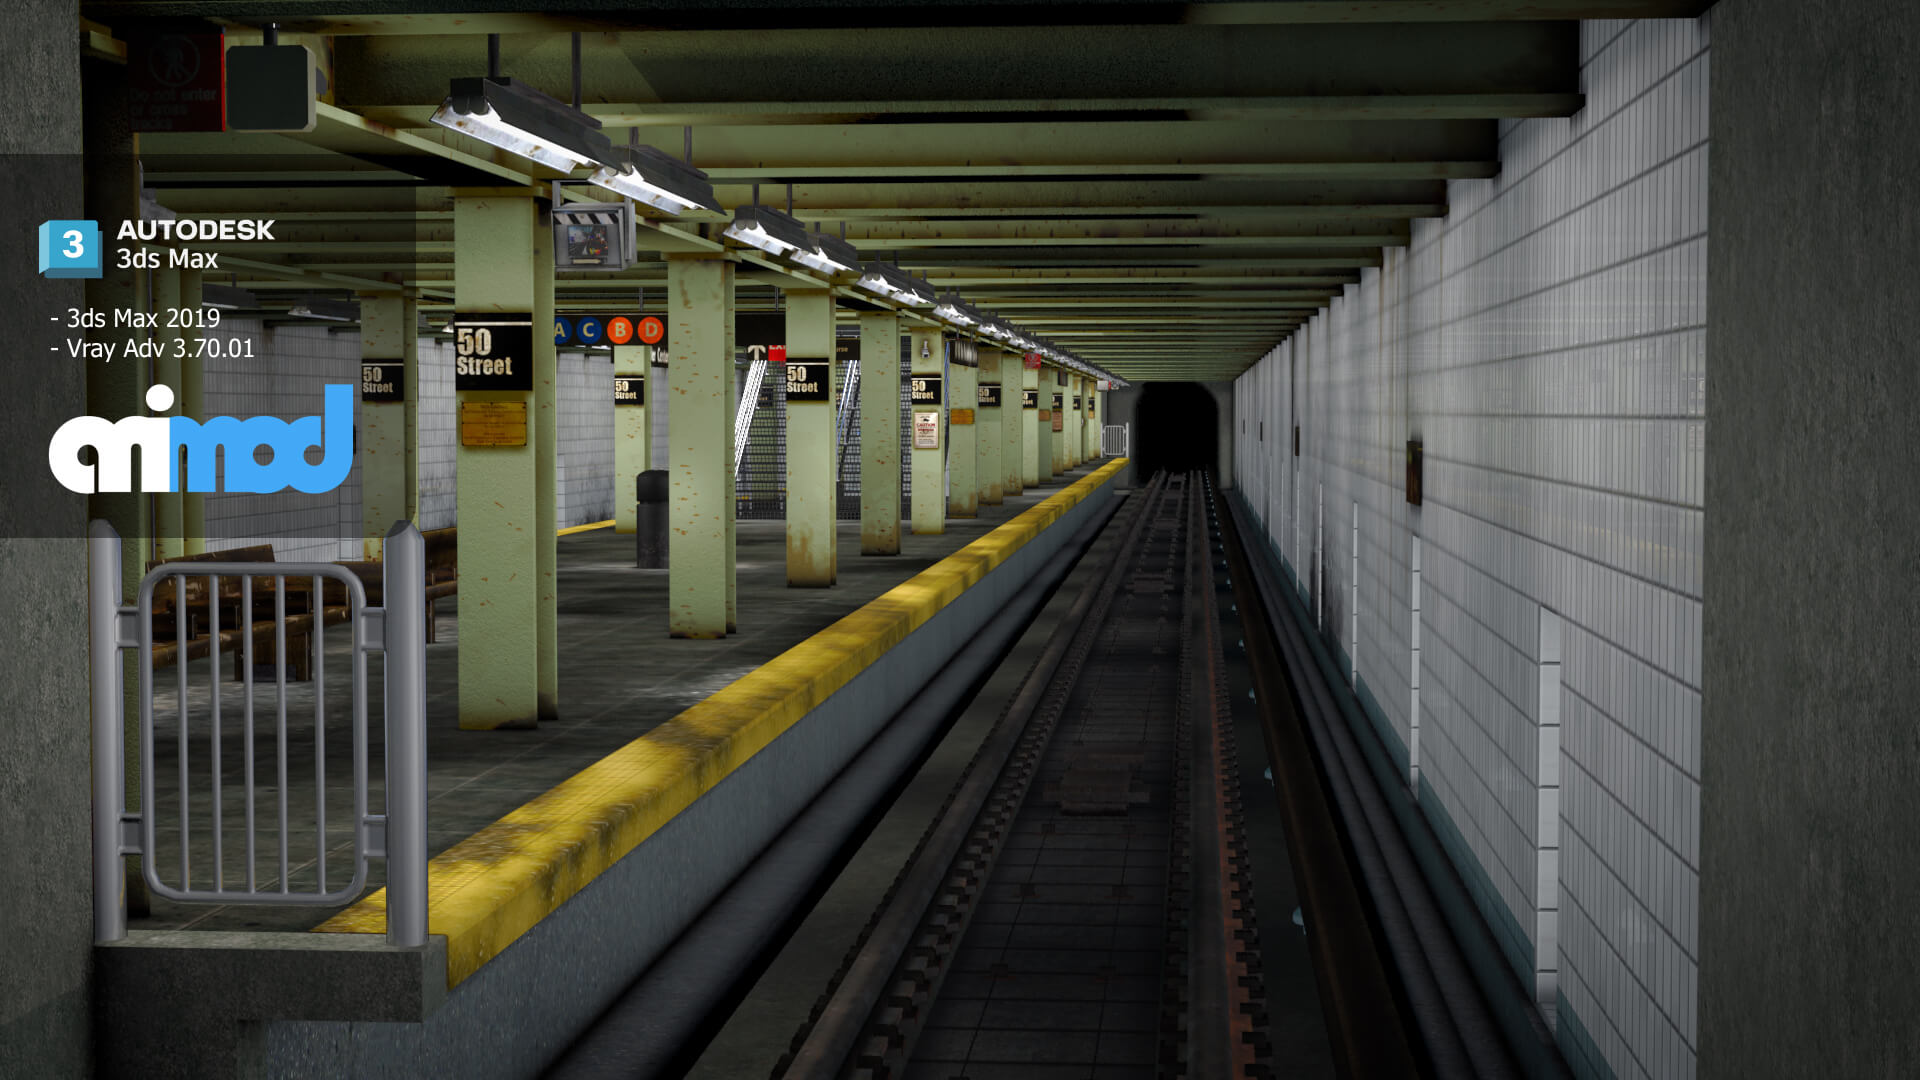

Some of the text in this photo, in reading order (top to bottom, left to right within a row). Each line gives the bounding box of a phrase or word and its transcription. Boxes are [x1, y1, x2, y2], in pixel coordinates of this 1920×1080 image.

[583, 322, 594, 337] C
[615, 322, 626, 337] B
[645, 322, 658, 337] D
[457, 328, 492, 355] 50
[457, 356, 513, 375] Street
[363, 366, 382, 382] 50
[787, 366, 807, 382] 50
[363, 382, 393, 393] Street
[615, 381, 629, 392] 50
[787, 382, 818, 392] Street
[912, 380, 926, 391] 50
[615, 391, 637, 399] Street
[912, 391, 934, 399] Street
